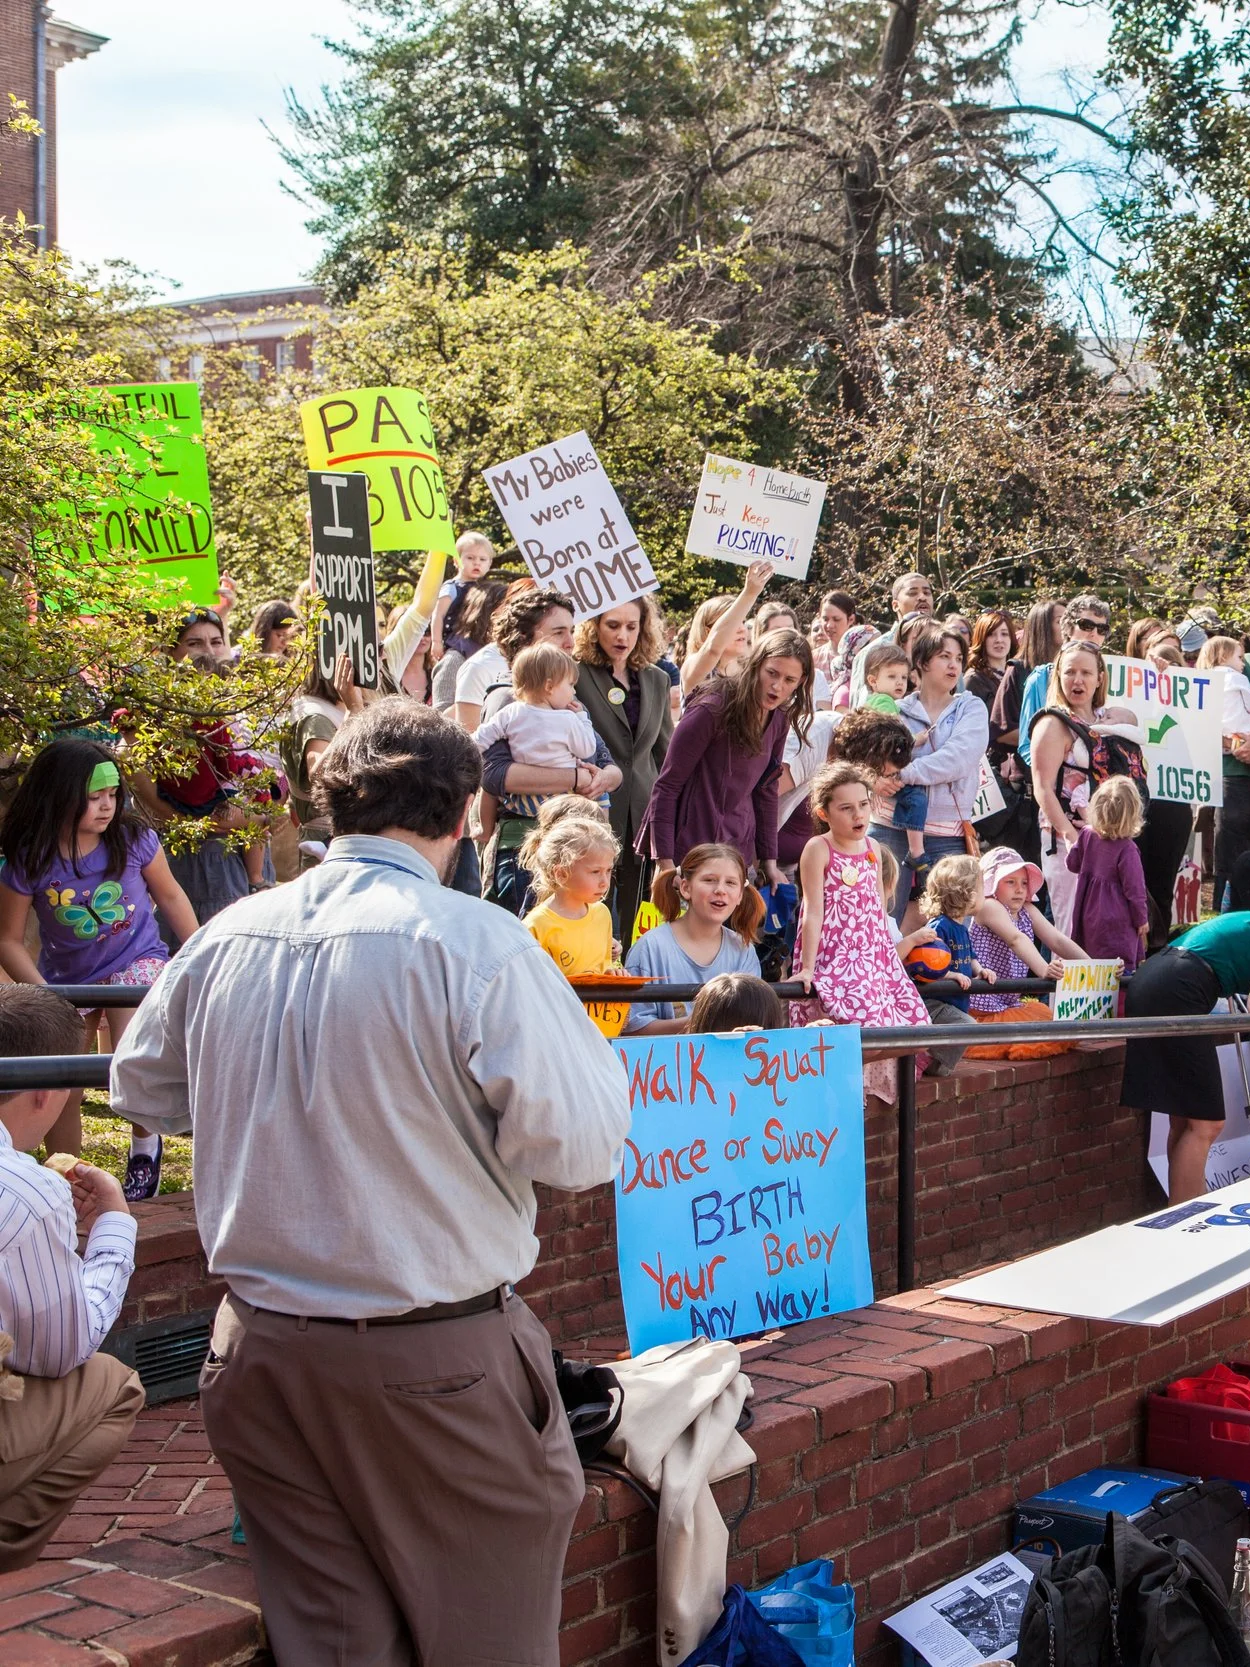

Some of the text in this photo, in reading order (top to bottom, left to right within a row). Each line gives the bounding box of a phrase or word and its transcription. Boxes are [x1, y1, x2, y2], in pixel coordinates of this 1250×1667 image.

[319, 396, 433, 453] PAS
[390, 465, 449, 521] 105
[491, 447, 599, 506] My Babies
[706, 456, 811, 501] Hope 4 Homebirth
[321, 475, 354, 539] I
[530, 494, 585, 526] were
[703, 493, 770, 530] Just Keep
[523, 507, 620, 579] Born at
[314, 552, 372, 602] SUPPORT
[548, 543, 657, 613] HOME
[320, 608, 376, 685] CPMs
[1107, 663, 1211, 710] UPPORT
[1156, 764, 1211, 802] 1056
[1061, 964, 1119, 992] MIDWIVES
[743, 1032, 835, 1107] Squat
[620, 1118, 838, 1195] Dance or Sway
[691, 1176, 804, 1250] BIRTH
[640, 1223, 840, 1312] Your Baby
[756, 1269, 830, 1326] Way!
